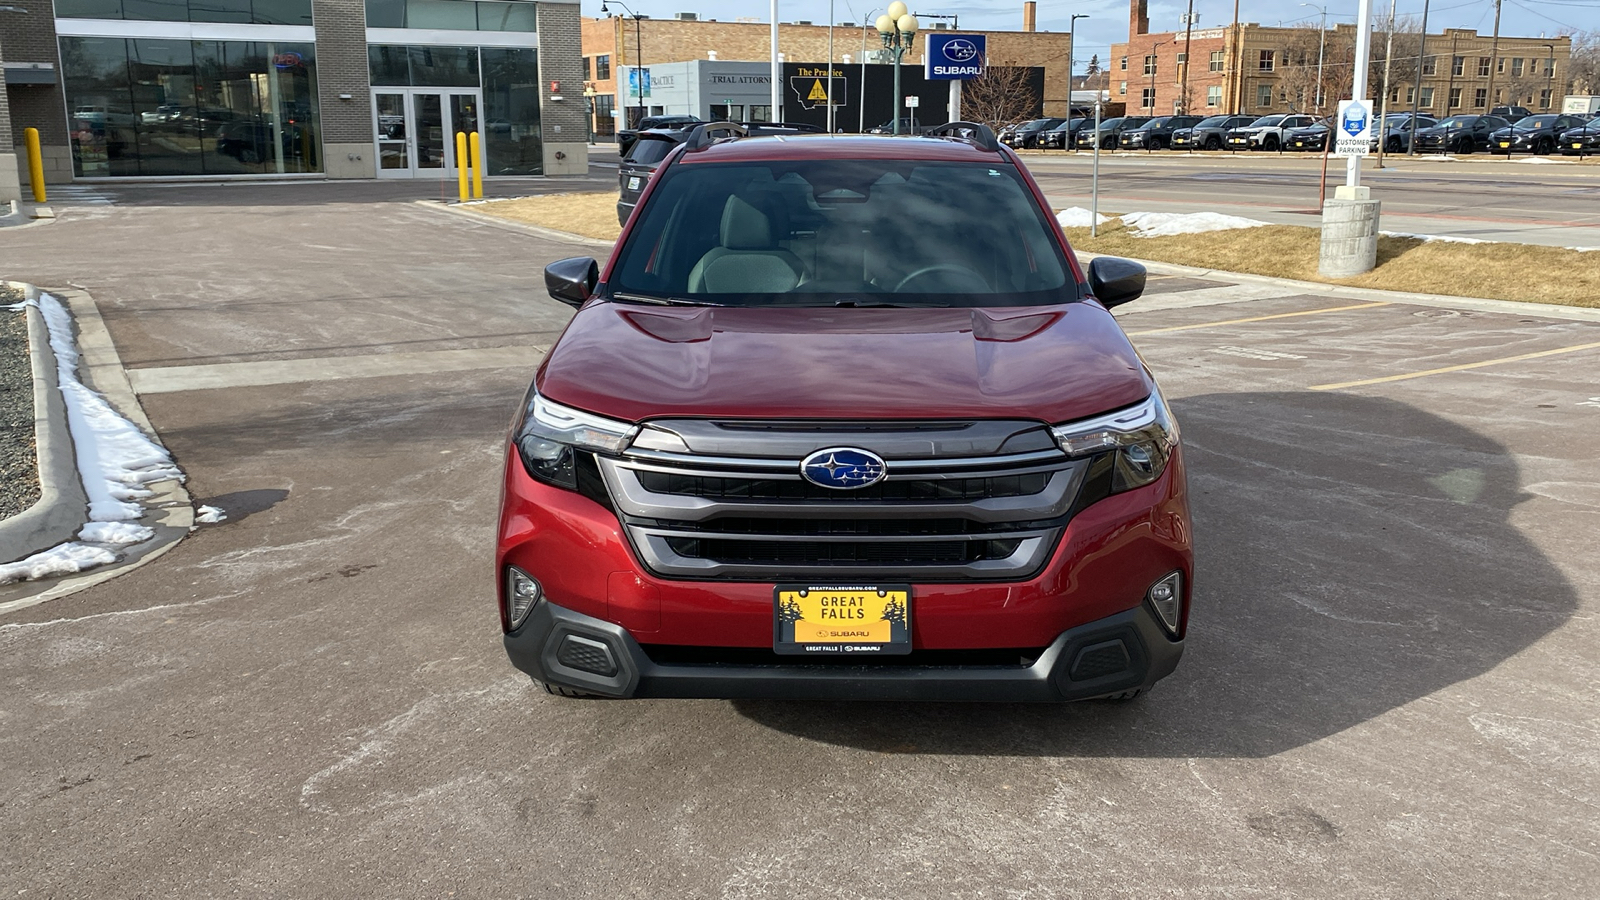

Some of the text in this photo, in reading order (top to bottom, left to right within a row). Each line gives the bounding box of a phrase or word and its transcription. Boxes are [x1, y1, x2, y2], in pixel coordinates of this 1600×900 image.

[797, 68, 843, 77] The Pracice
[934, 66, 982, 75] SUBARU
[651, 75, 674, 86] PRACTICE
[712, 76, 736, 84] TRIAL
[821, 596, 865, 607] GREAT
[821, 608, 865, 619] FALLS
